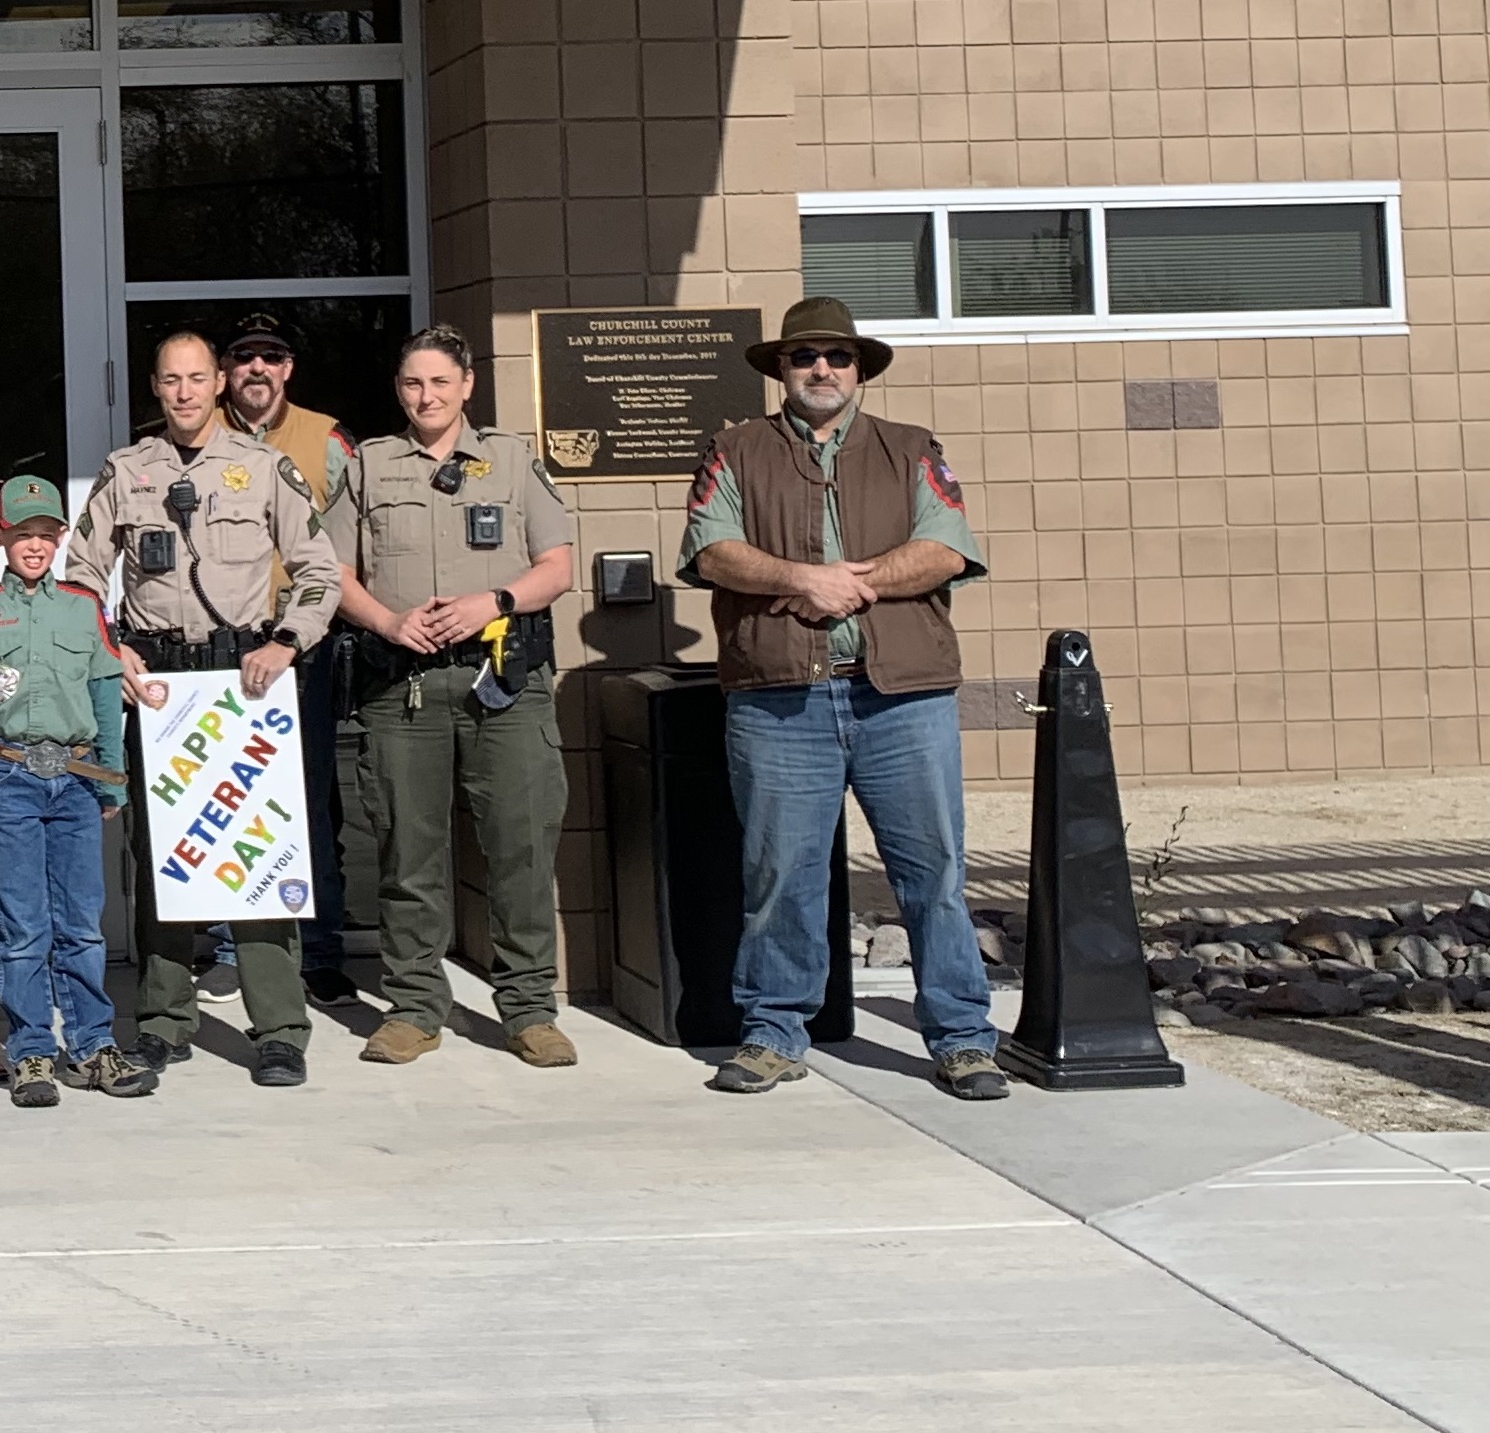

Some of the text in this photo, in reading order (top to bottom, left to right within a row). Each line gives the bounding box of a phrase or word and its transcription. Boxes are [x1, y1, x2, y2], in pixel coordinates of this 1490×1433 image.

[567, 333, 734, 346] LAW ENFORCEMENT CENTER
[589, 319, 710, 331] CHURCHILL COUNTY
[149, 687, 246, 807] HAPPY
[159, 707, 294, 885] VETERAN'S
[213, 814, 276, 893] DAY
[245, 872, 278, 906] THANK
[274, 850, 295, 875] YOU
